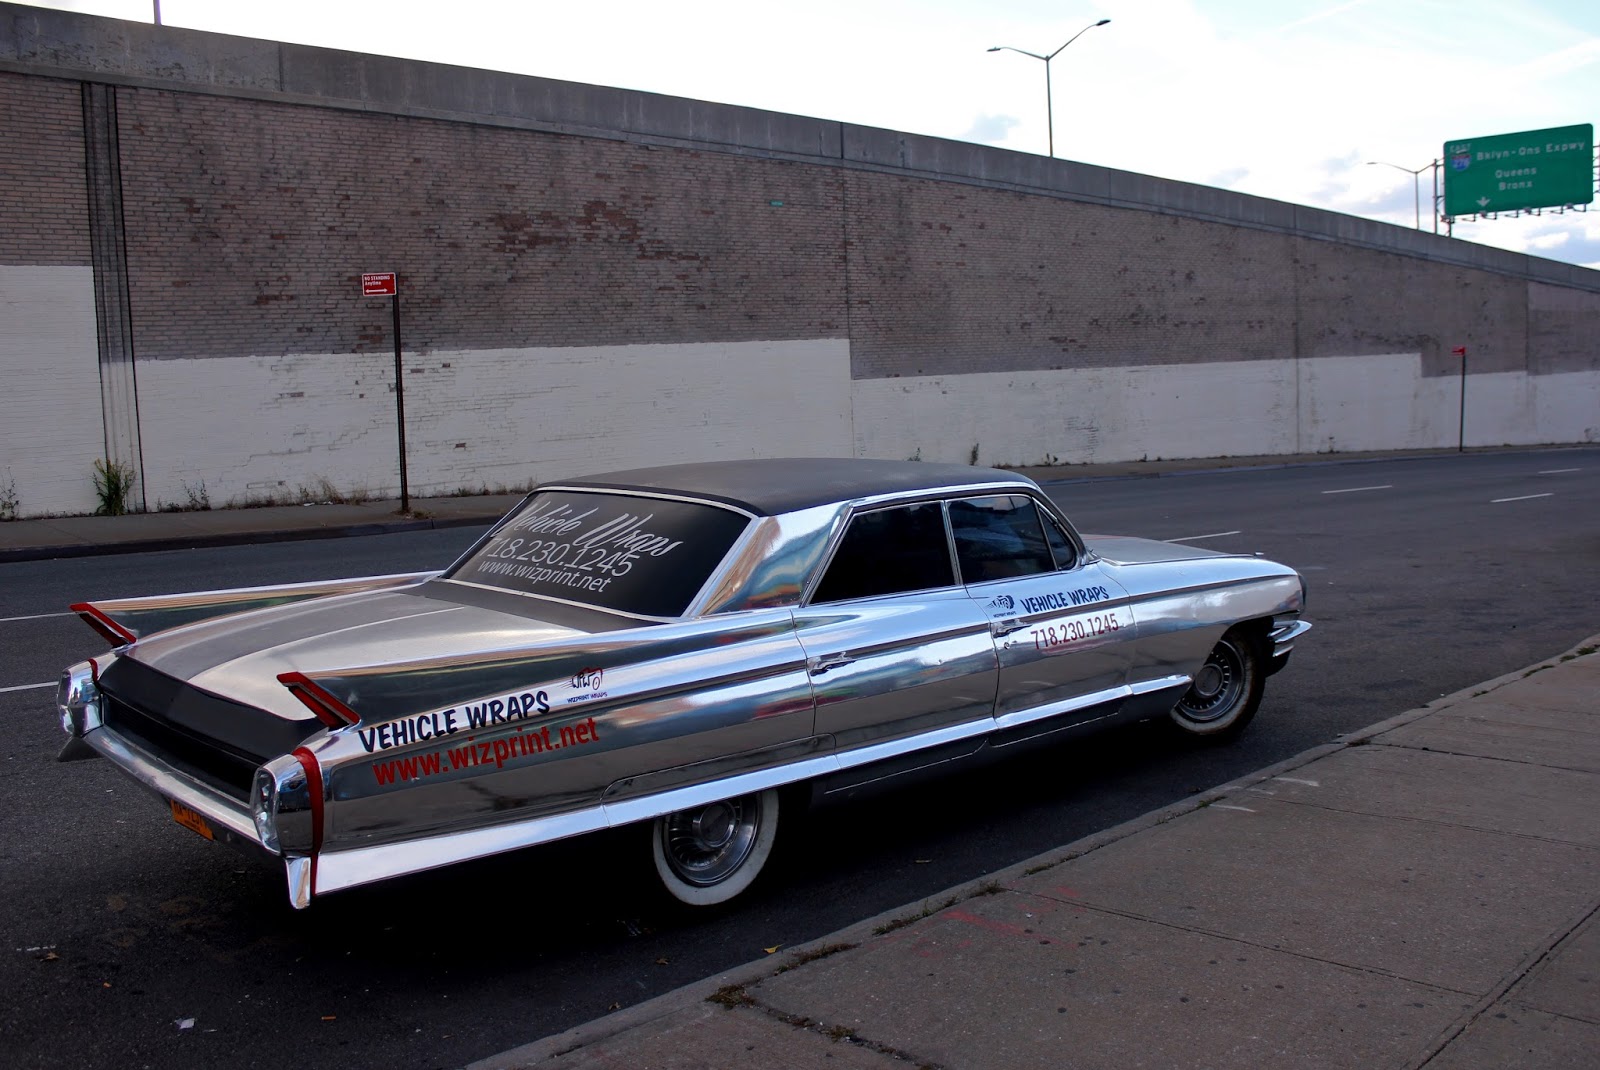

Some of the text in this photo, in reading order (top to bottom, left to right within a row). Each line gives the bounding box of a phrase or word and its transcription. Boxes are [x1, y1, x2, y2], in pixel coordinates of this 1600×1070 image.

[1545, 140, 1585, 153] Expwy
[1495, 166, 1537, 179] Queens
[1498, 180, 1533, 191] Bronx
[572, 512, 684, 557] Wraps
[479, 537, 641, 577] 718.230.1245
[477, 559, 612, 593] www.wizprint.net
[1020, 592, 1069, 614] VEHICLE
[1067, 585, 1110, 606] WRAPS
[1030, 613, 1120, 650] 718.230.1245
[357, 690, 550, 753] VEHICLE WRAPS
[371, 717, 600, 786] www.wizprint.net
